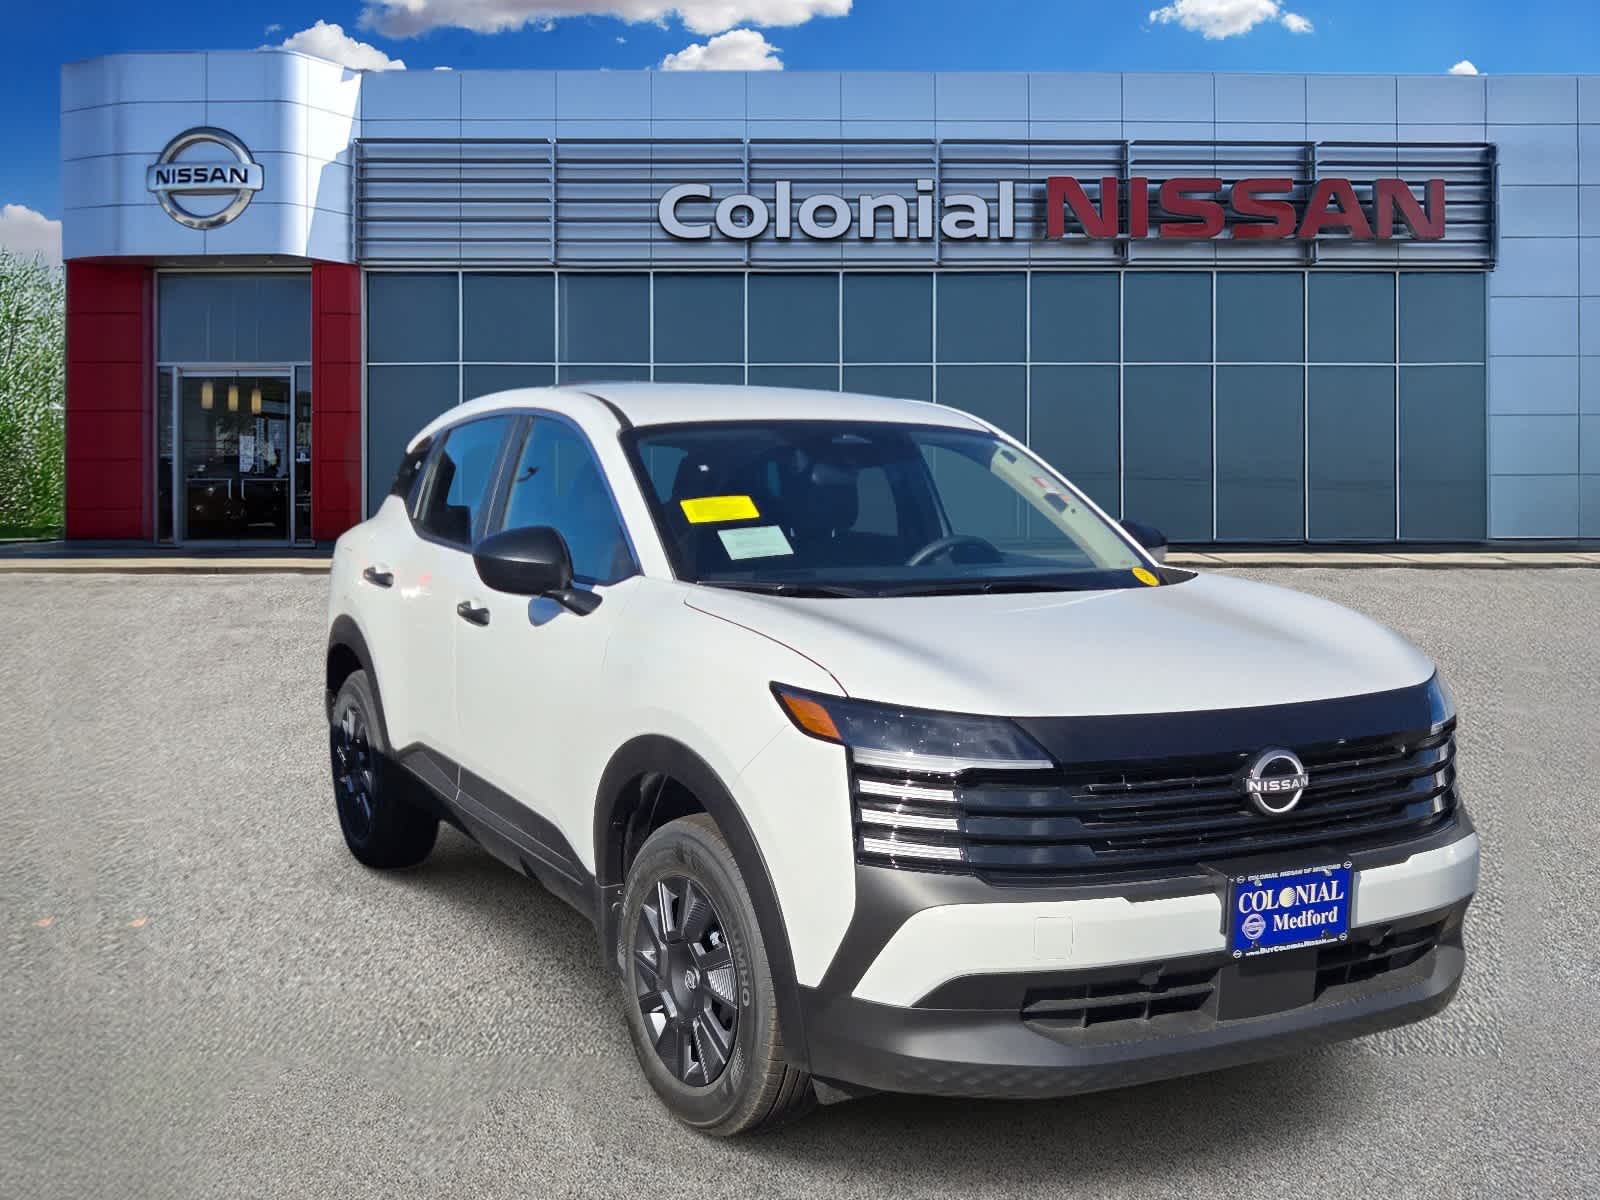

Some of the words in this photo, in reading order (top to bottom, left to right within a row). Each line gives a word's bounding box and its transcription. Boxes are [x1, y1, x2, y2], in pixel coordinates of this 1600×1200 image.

[156, 167, 249, 185] NISSAN
[658, 178, 1014, 240] Colonial
[1045, 175, 1446, 240] NISSAN
[1248, 775, 1309, 792] NISSAN
[1238, 880, 1345, 914] COLONIAL
[1272, 906, 1338, 932] Medford
